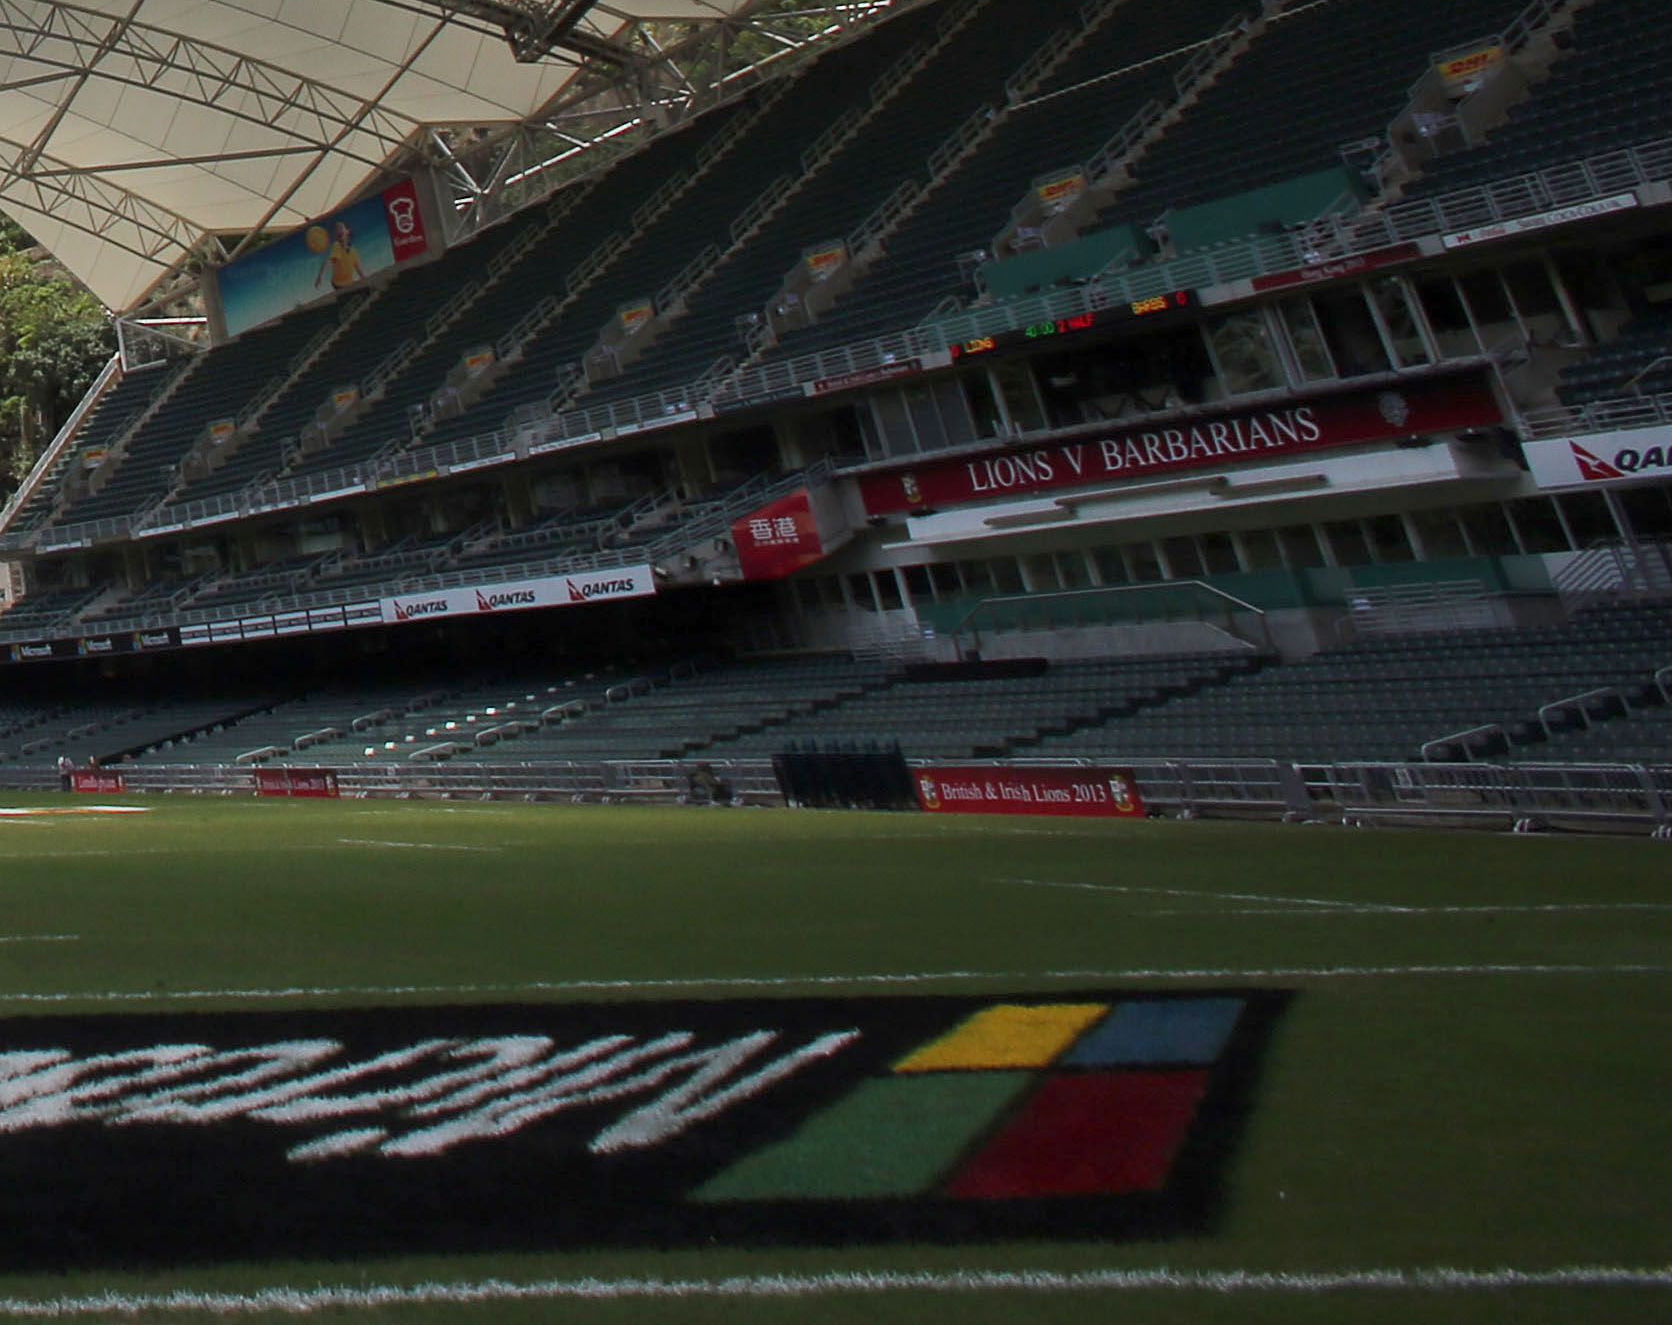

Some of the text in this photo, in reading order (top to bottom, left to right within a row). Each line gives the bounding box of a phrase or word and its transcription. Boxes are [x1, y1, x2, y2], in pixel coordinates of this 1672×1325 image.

[967, 407, 1321, 492] LIONS V BARBARIANS
[1614, 444, 1672, 473] QA
[749, 516, 798, 540] 香港
[489, 590, 535, 608] QANTAS
[581, 578, 634, 598] QANTAS
[405, 599, 448, 617] QANTAS
[940, 781, 1106, 803] British & Irish Lions 2013
